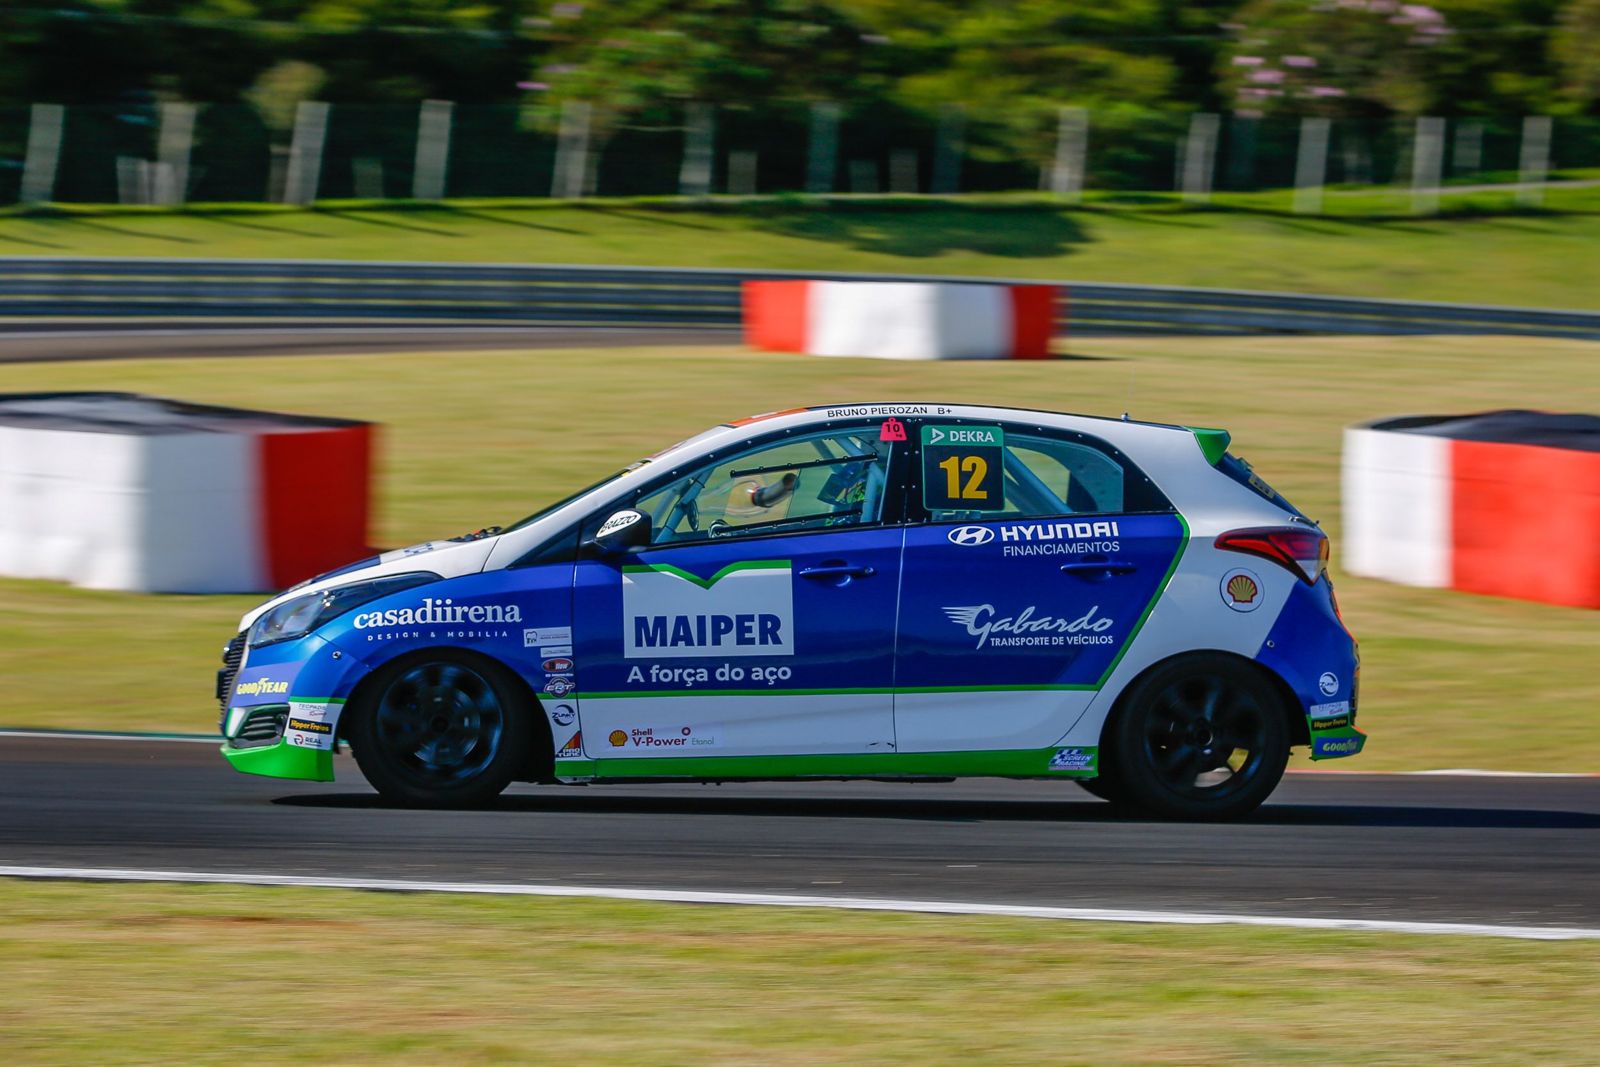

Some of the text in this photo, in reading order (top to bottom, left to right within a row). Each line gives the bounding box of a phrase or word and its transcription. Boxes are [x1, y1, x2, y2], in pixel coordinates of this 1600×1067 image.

[827, 406, 952, 418] BRUNO PIEROZAN B+
[885, 423, 901, 433] 10
[950, 430, 995, 443] DEKRA
[939, 455, 988, 499] 12
[1000, 521, 1120, 542] HYUNDAI
[1003, 541, 1120, 557] FINANCIAMENTOS
[353, 598, 522, 629] casadiirena
[634, 613, 783, 648] MAIPER
[941, 603, 1114, 650] Gabardo
[367, 631, 419, 641] DESIGN
[990, 633, 1114, 647] TRANSPORTE DE VEÍCULOS
[627, 663, 792, 687] A força do aço
[237, 678, 288, 696] GOODYEAR
[632, 728, 653, 736] Shell
[632, 736, 687, 747] V-Power
